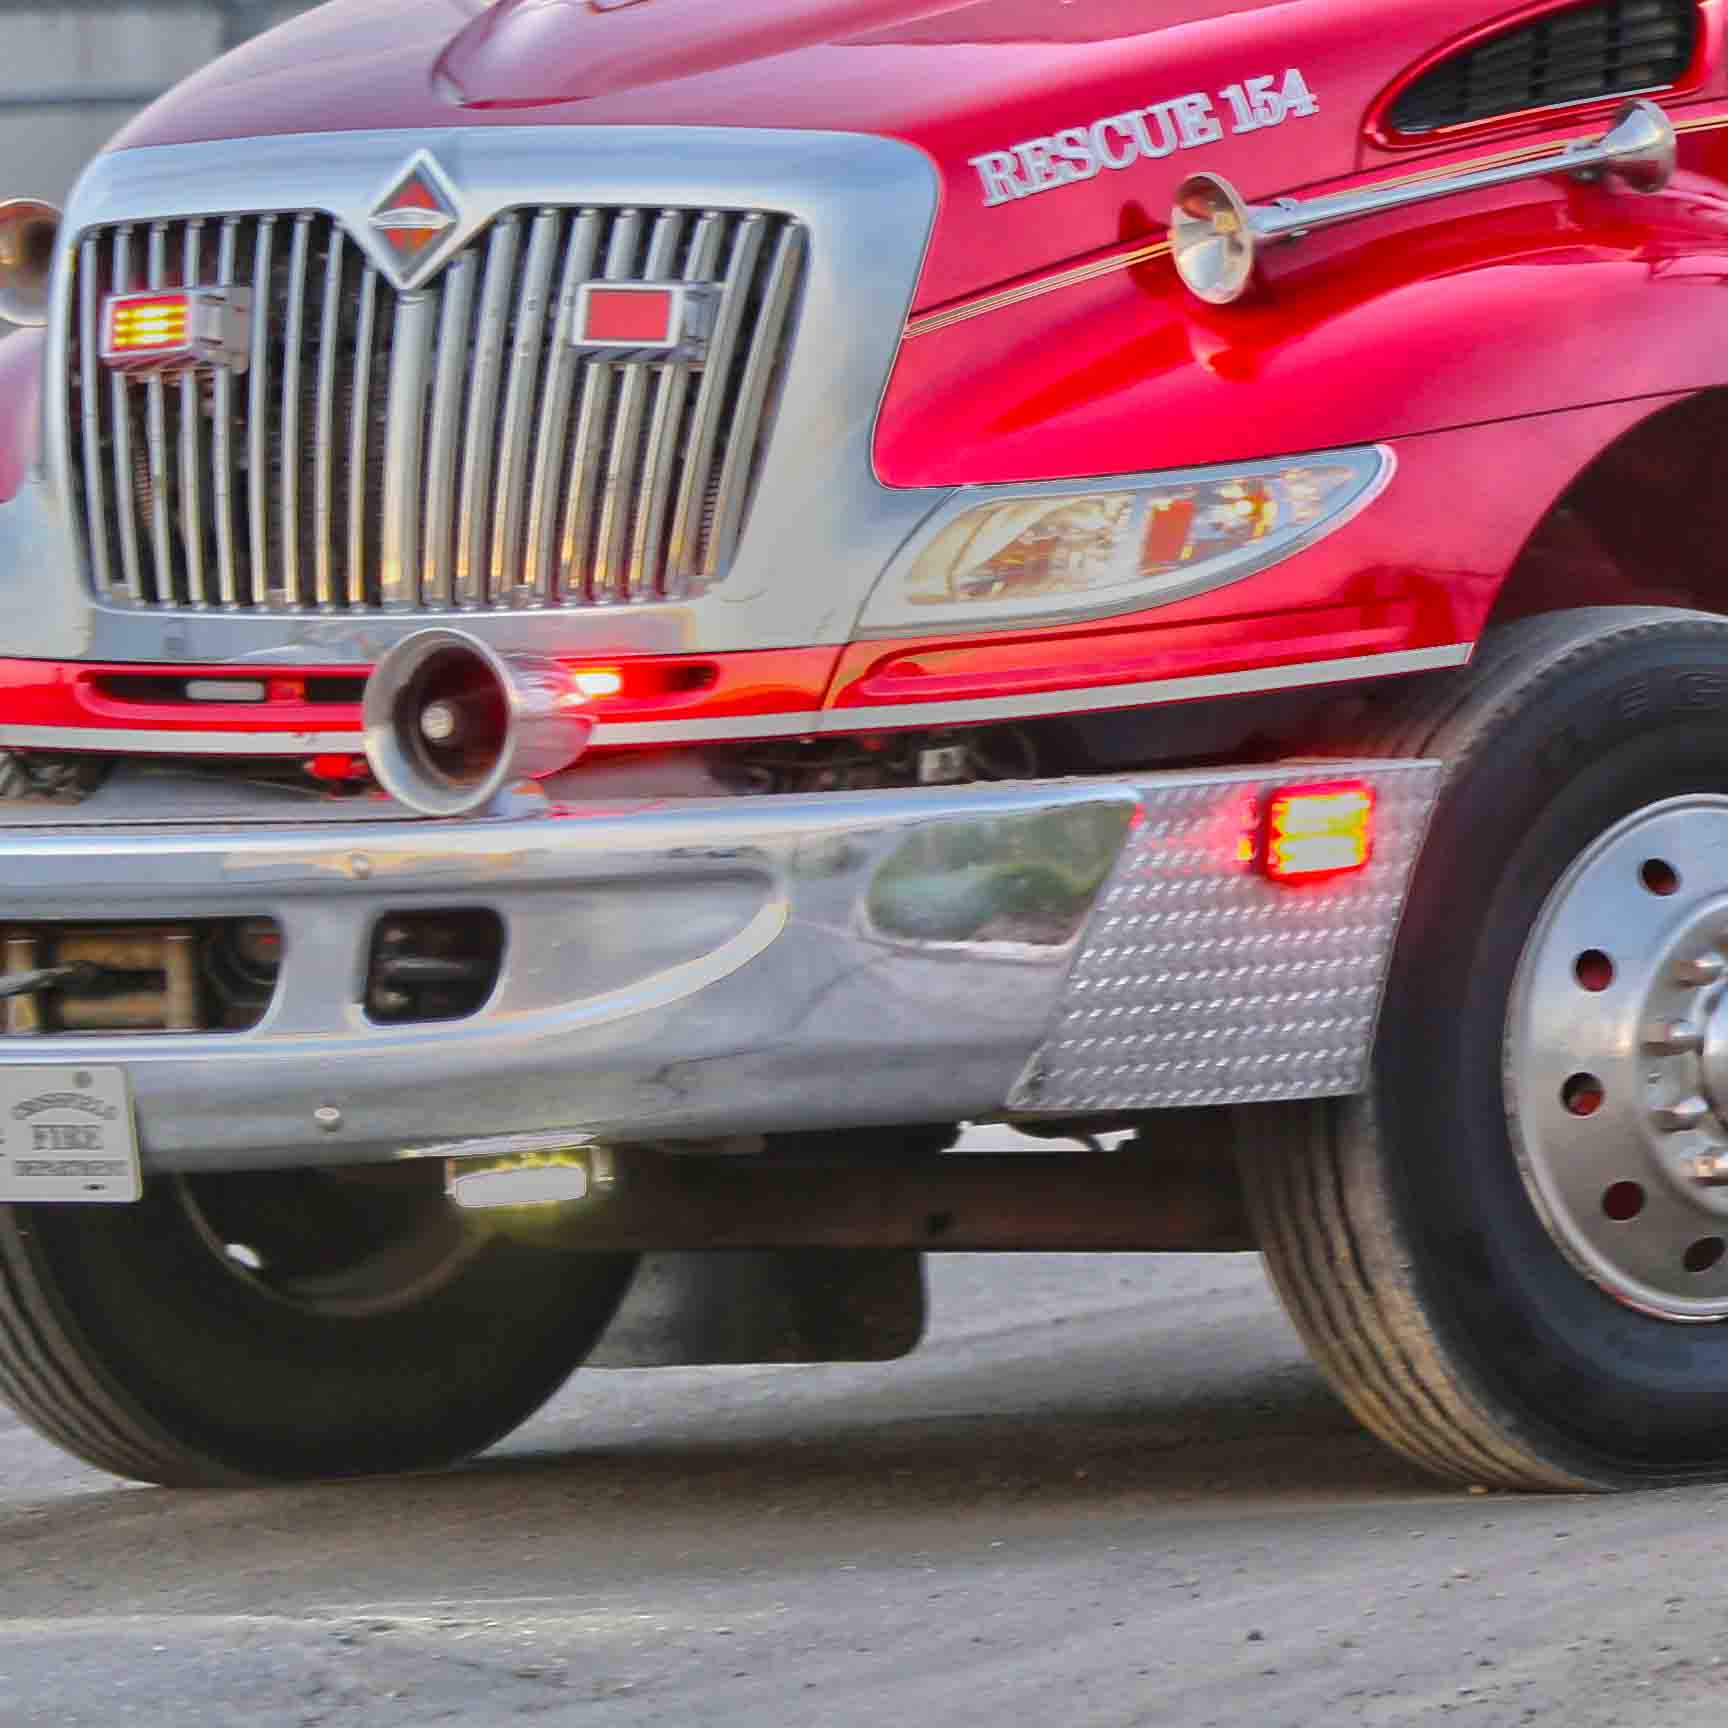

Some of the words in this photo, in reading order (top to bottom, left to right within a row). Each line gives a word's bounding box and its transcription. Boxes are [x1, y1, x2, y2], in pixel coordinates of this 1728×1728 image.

[967, 91, 1224, 207] RESCUE
[1218, 67, 1320, 135] 154
[30, 1124, 103, 1151] FIRE
